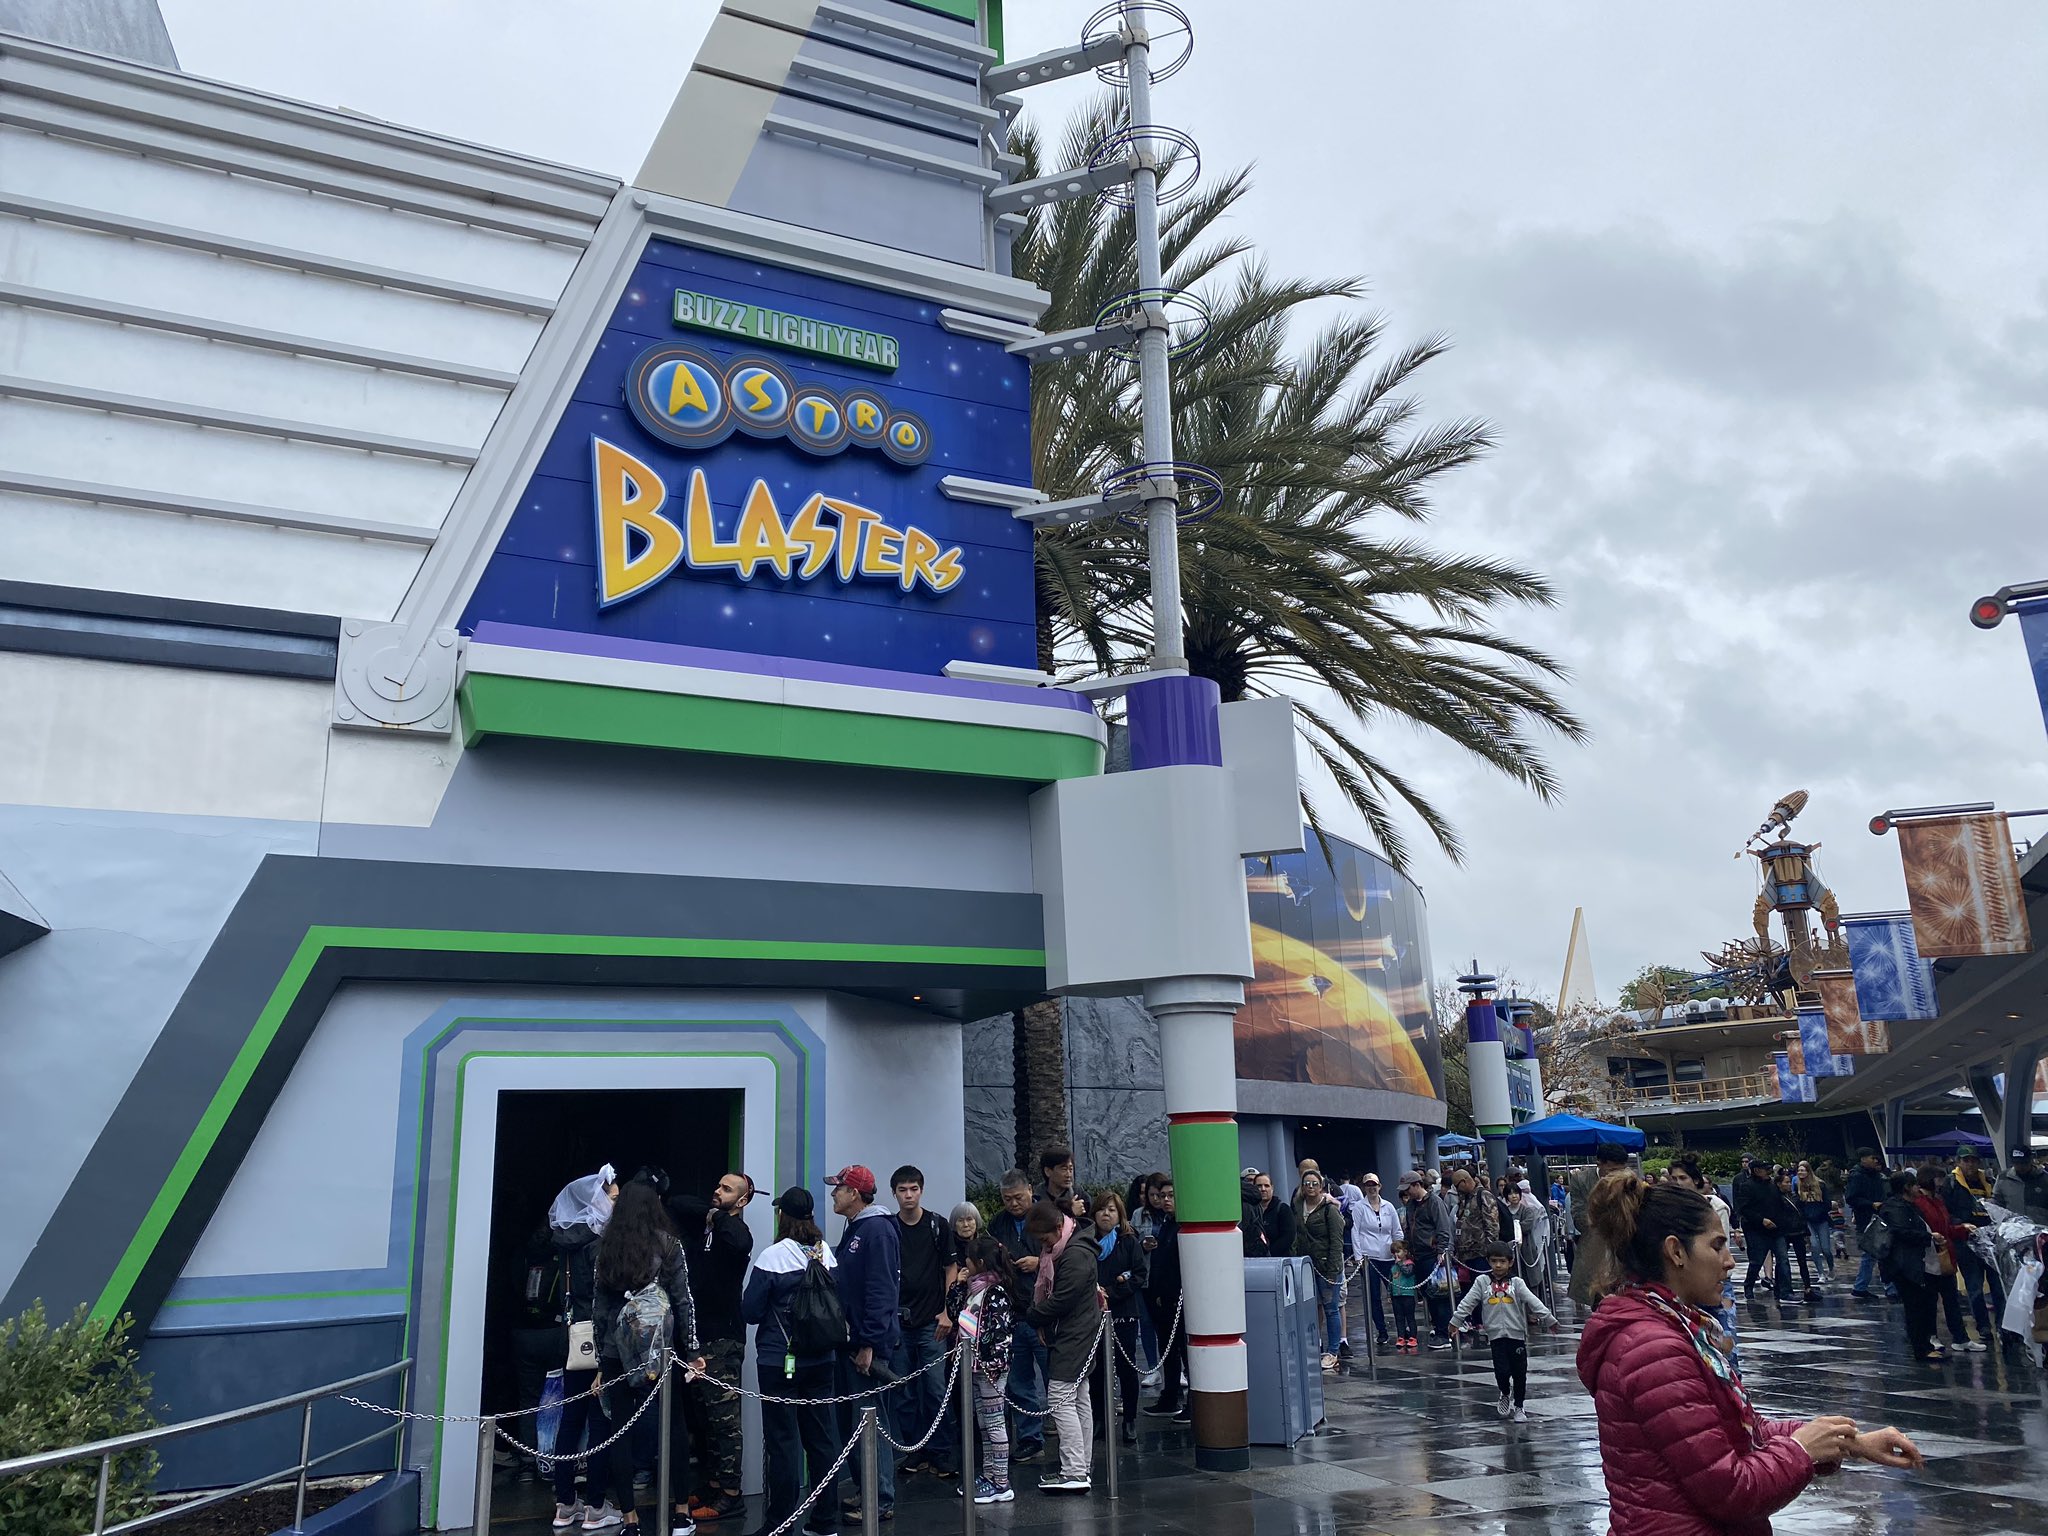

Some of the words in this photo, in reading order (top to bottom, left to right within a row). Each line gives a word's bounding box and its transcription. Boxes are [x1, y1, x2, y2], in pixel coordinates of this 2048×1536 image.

[677, 290, 747, 334] BUZZ
[757, 309, 898, 367] LIGHTYEAR
[655, 360, 919, 452] ASTRO
